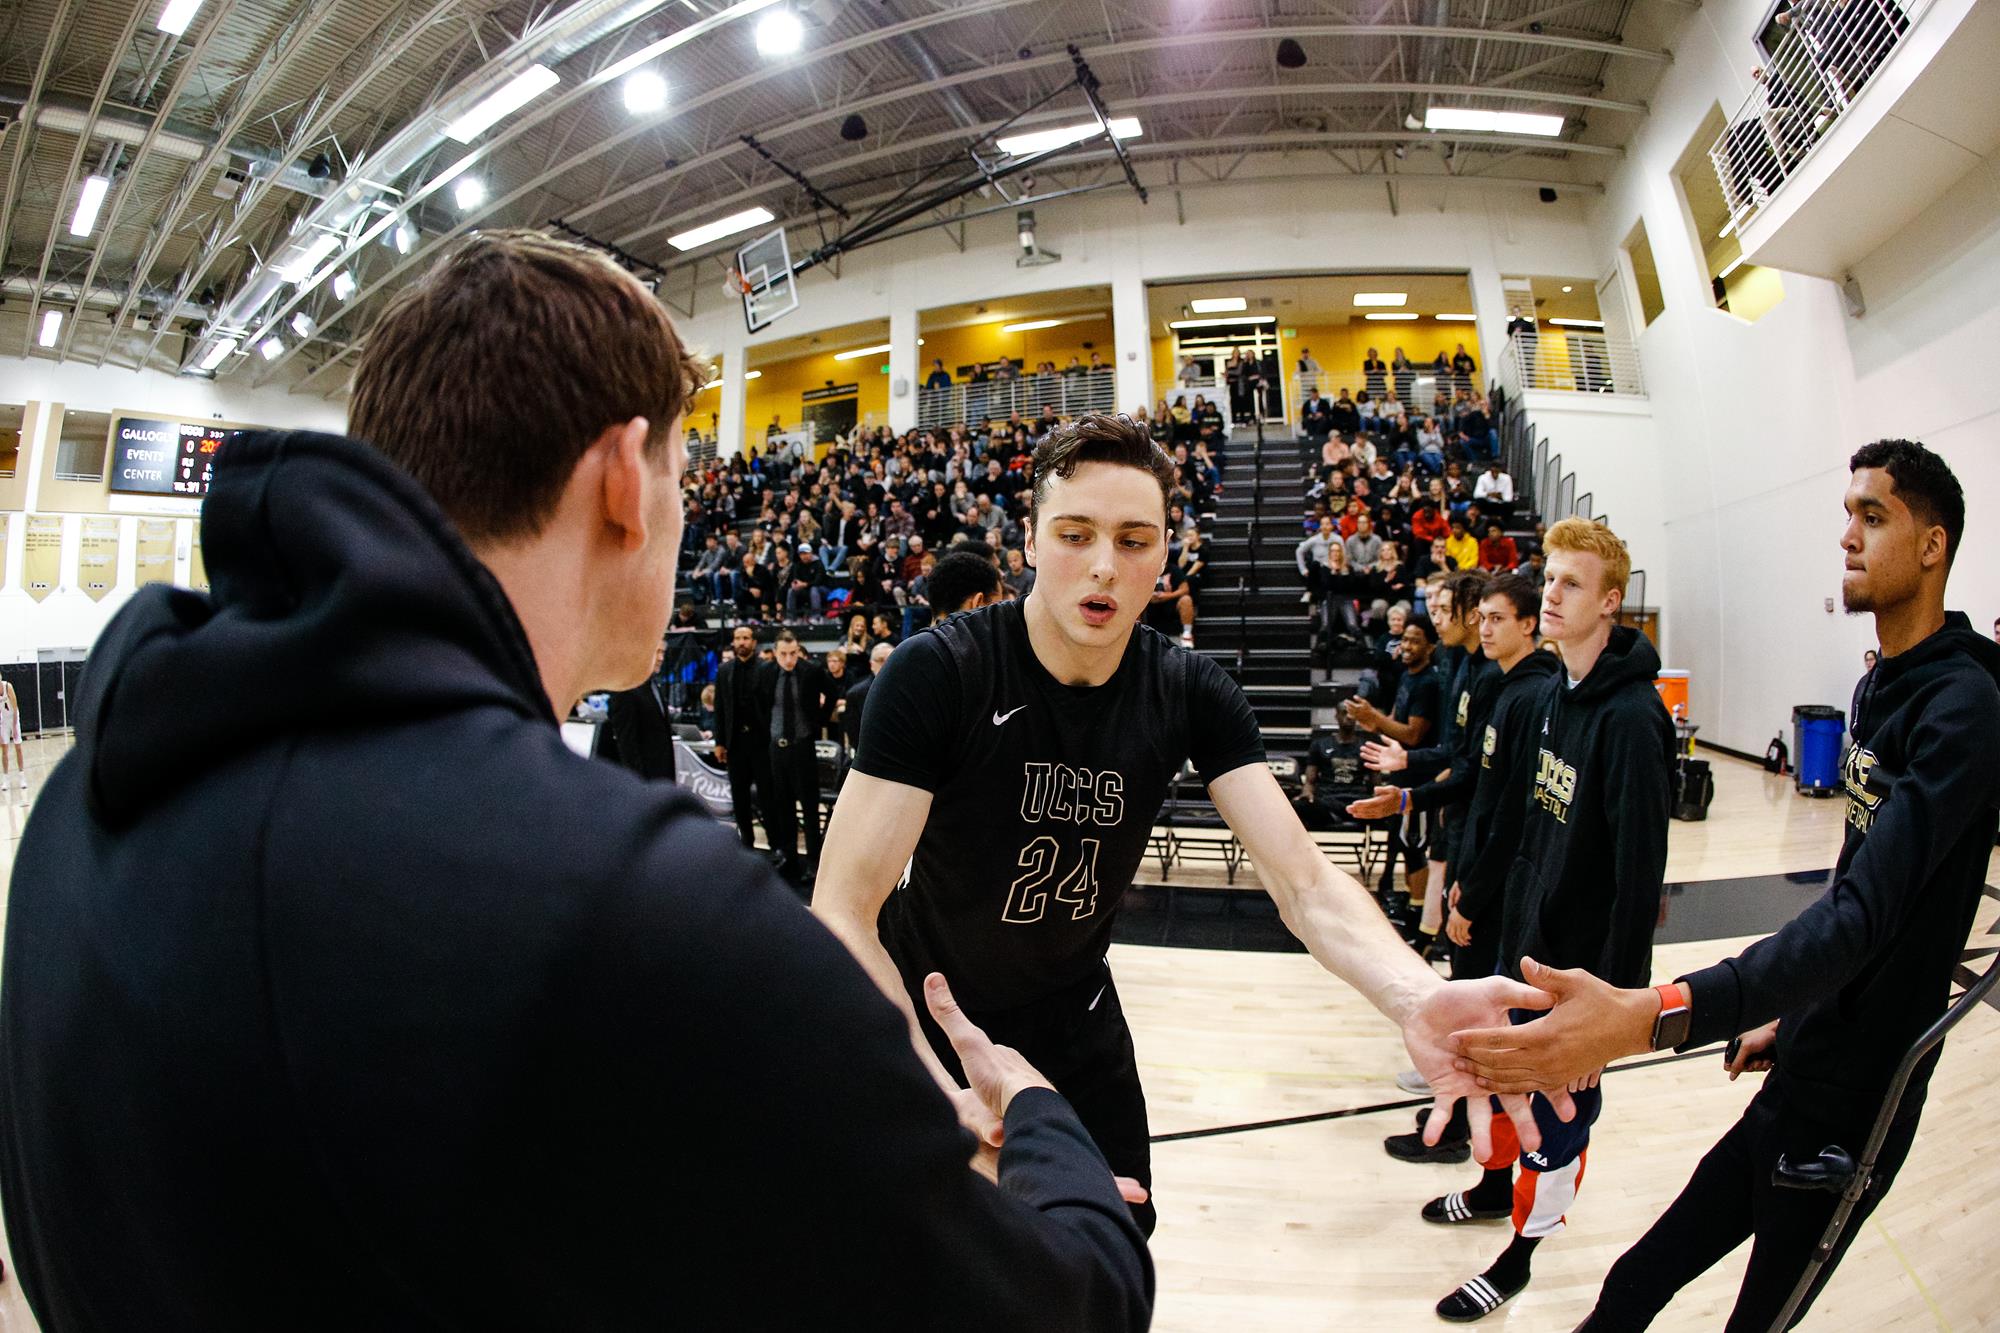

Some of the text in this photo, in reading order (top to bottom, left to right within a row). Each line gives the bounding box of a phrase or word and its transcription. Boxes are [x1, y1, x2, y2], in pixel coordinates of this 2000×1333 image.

[127, 448, 165, 463] EVENTS
[123, 468, 162, 481] CENTER
[1020, 762, 1124, 826] UCCS
[1001, 836, 1100, 923] 24
[1526, 1151, 1548, 1167] FILA
